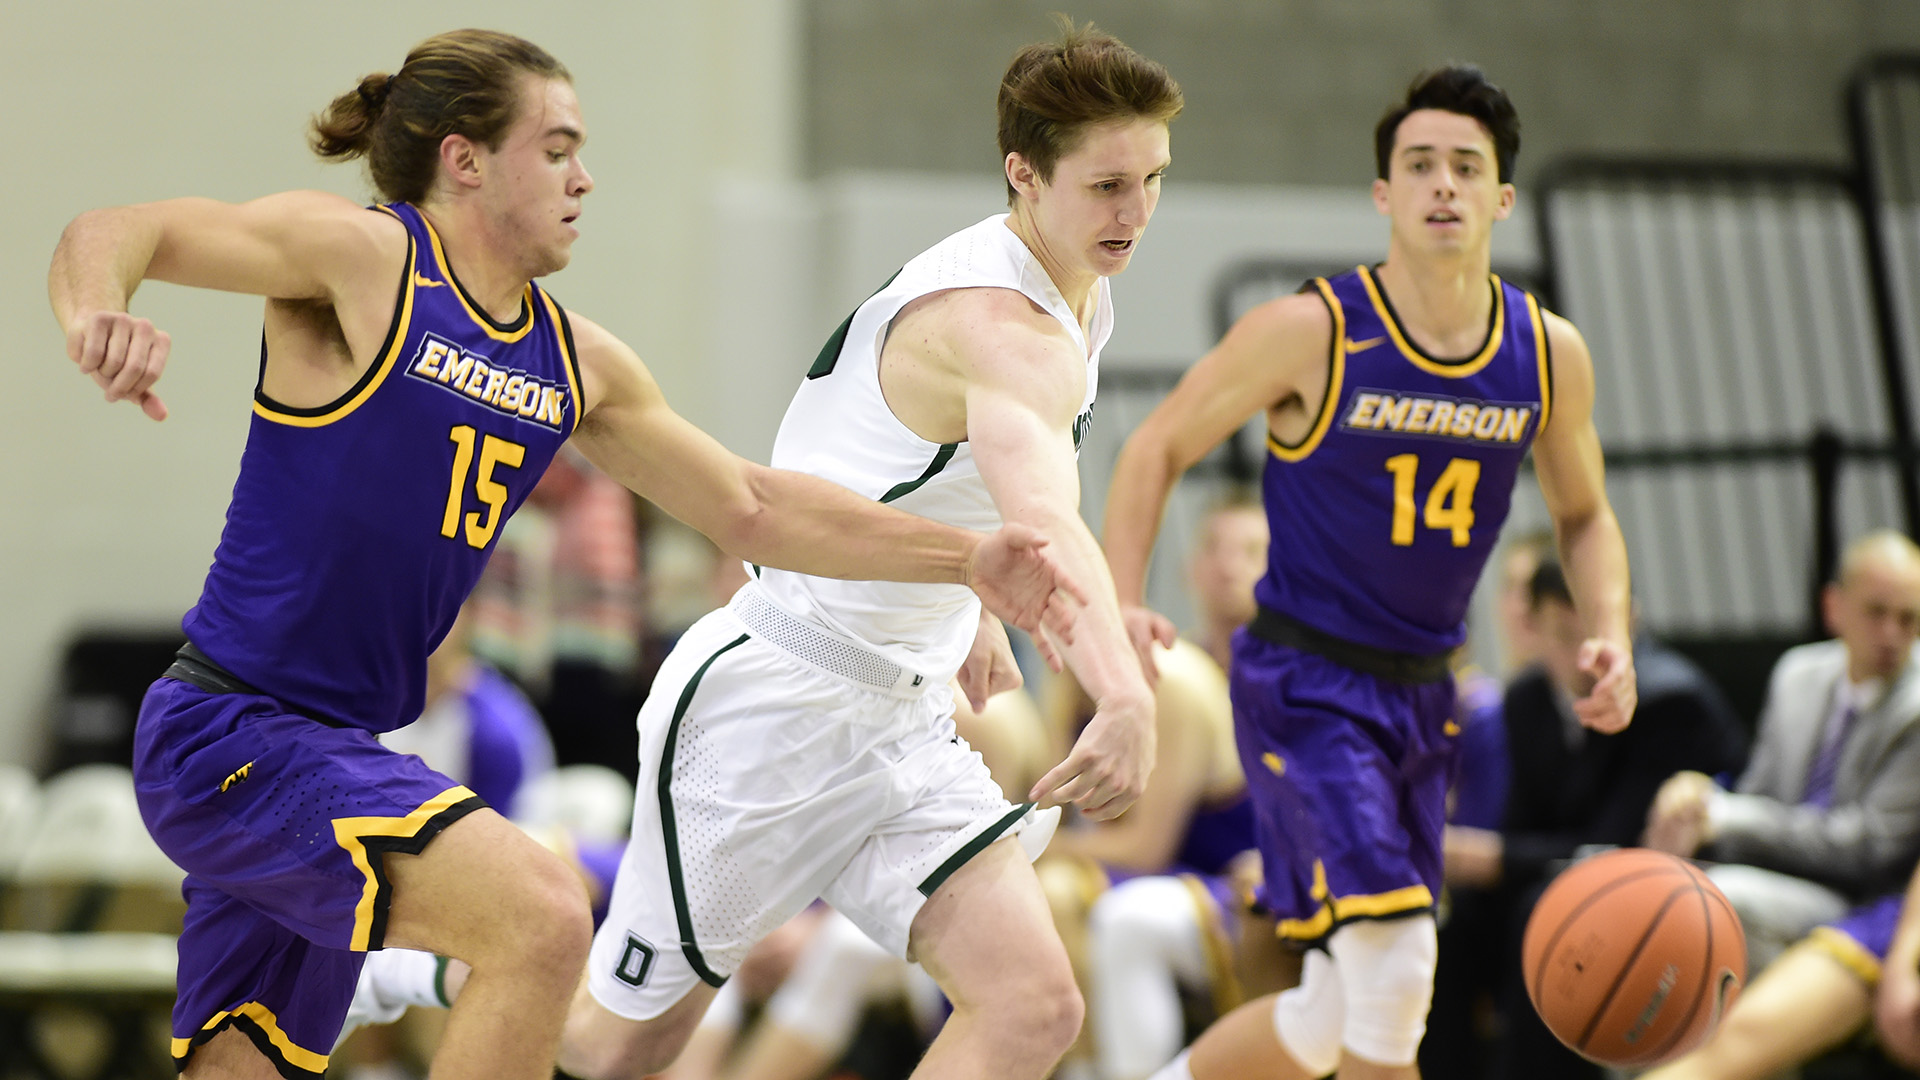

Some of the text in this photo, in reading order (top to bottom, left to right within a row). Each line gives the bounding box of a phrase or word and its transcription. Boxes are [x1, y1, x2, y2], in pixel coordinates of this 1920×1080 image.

[414, 338, 565, 426] EMERSON
[1347, 392, 1531, 443] EMERSON
[440, 424, 526, 550] 15
[1384, 453, 1482, 548] 14
[613, 932, 656, 988] D
